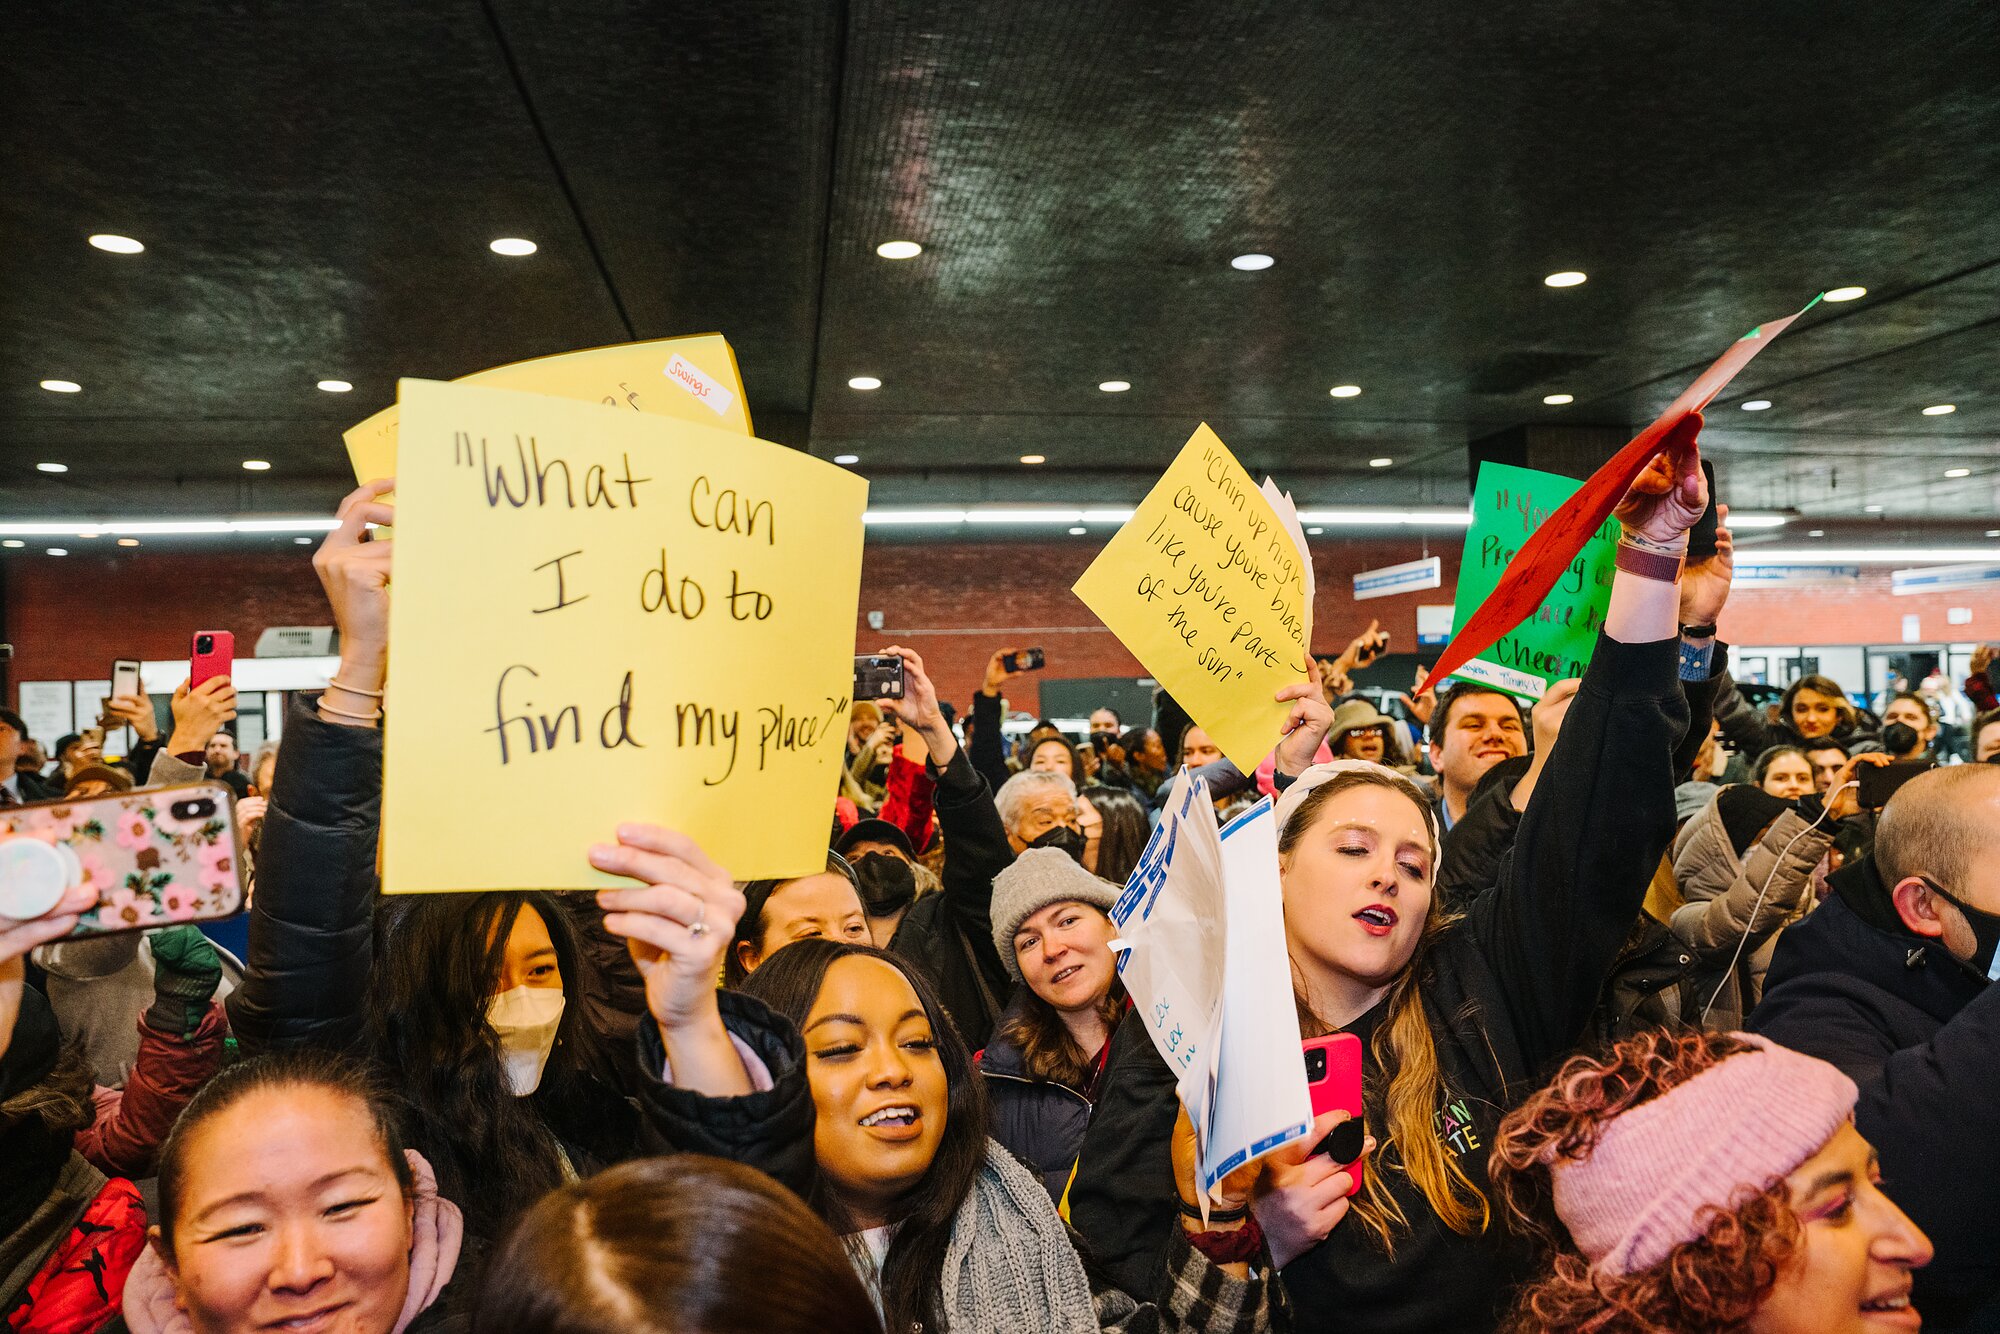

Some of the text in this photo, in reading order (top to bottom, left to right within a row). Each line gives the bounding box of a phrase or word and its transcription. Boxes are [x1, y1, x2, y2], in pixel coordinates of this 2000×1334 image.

[669, 361, 711, 397] Swings
[690, 475, 775, 545] can
[532, 548, 773, 622] I do to
[1217, 533, 1268, 590] you're
[1248, 509, 1268, 540] up
[1268, 531, 1304, 596] high
[1137, 573, 1164, 602] of
[1167, 604, 1198, 648] the
[1146, 514, 1280, 668] like you're part
[485, 664, 647, 765] find
[676, 703, 739, 786] my
[1163, 1022, 1184, 1053] Lex
